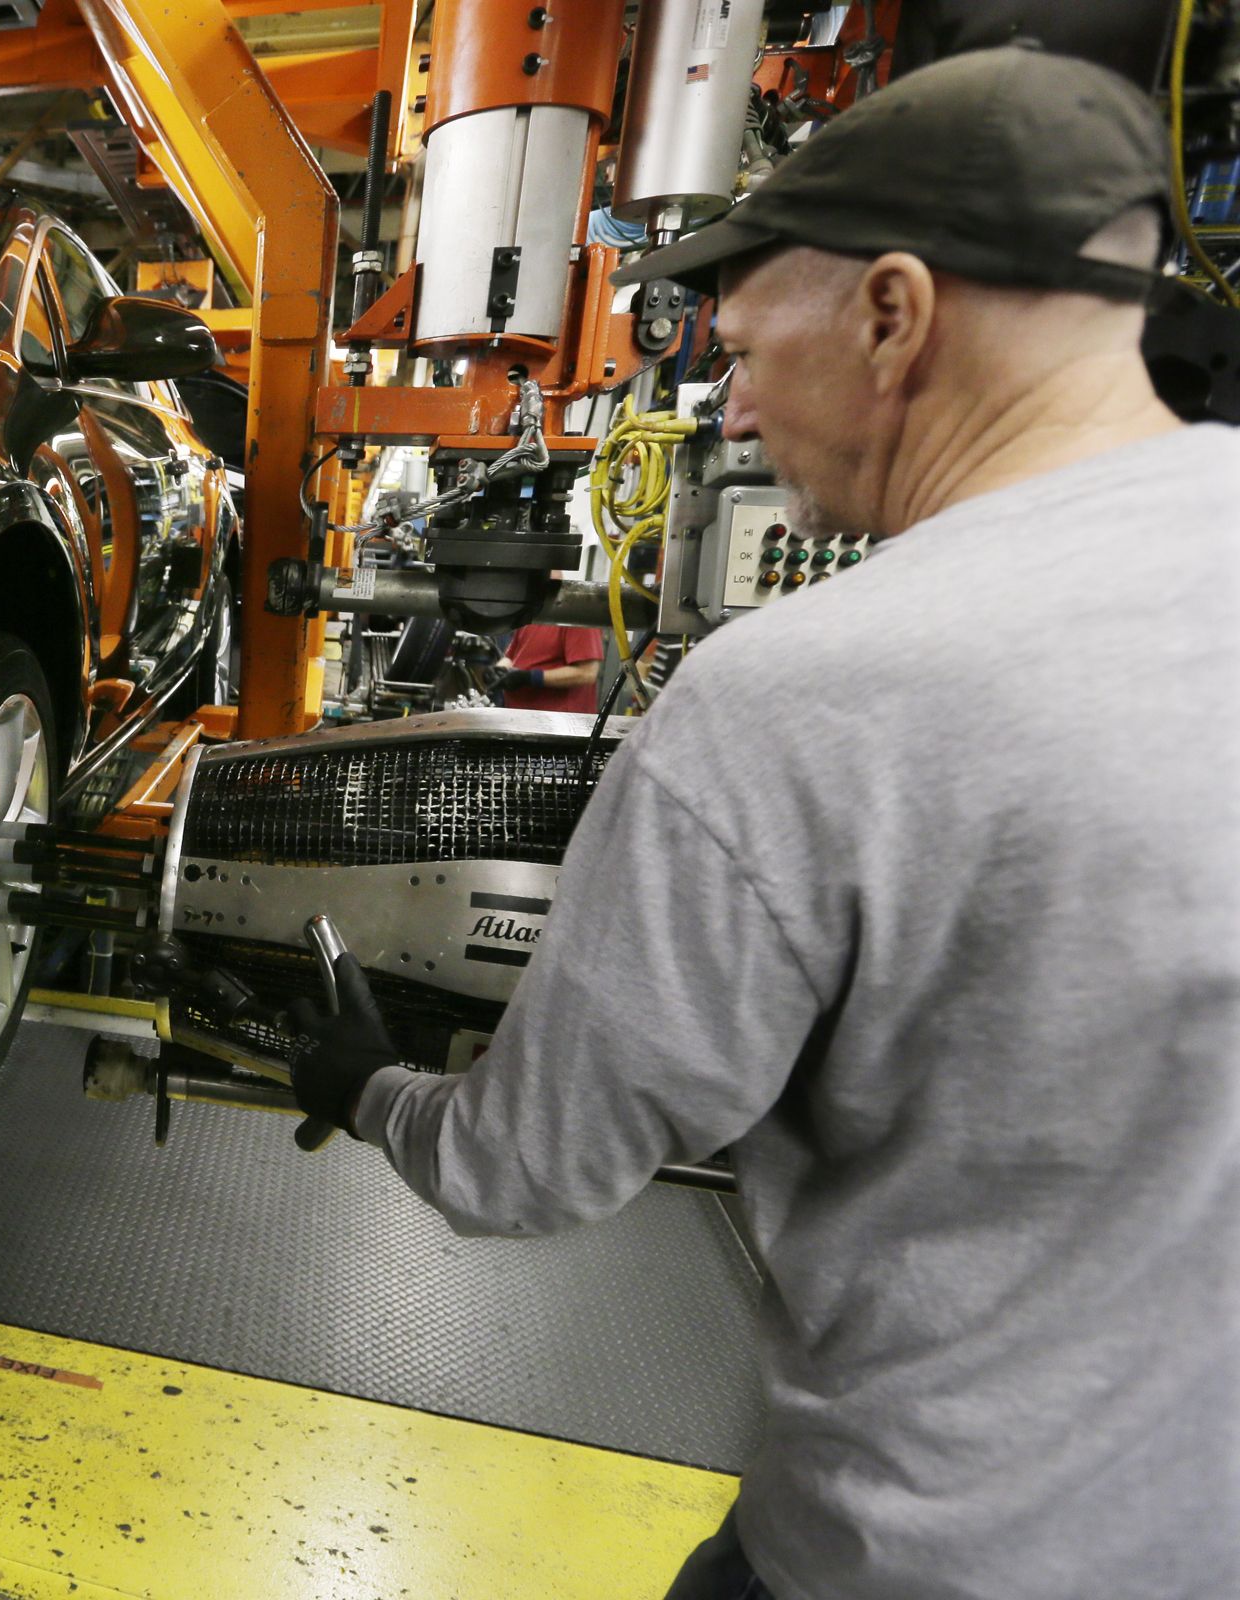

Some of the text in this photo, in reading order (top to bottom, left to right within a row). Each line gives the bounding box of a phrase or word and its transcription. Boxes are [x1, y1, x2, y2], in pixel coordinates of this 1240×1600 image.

[772, 511, 777, 522] 1
[744, 529, 754, 537] HI
[740, 552, 753, 560] OK
[733, 576, 754, 584] LOW
